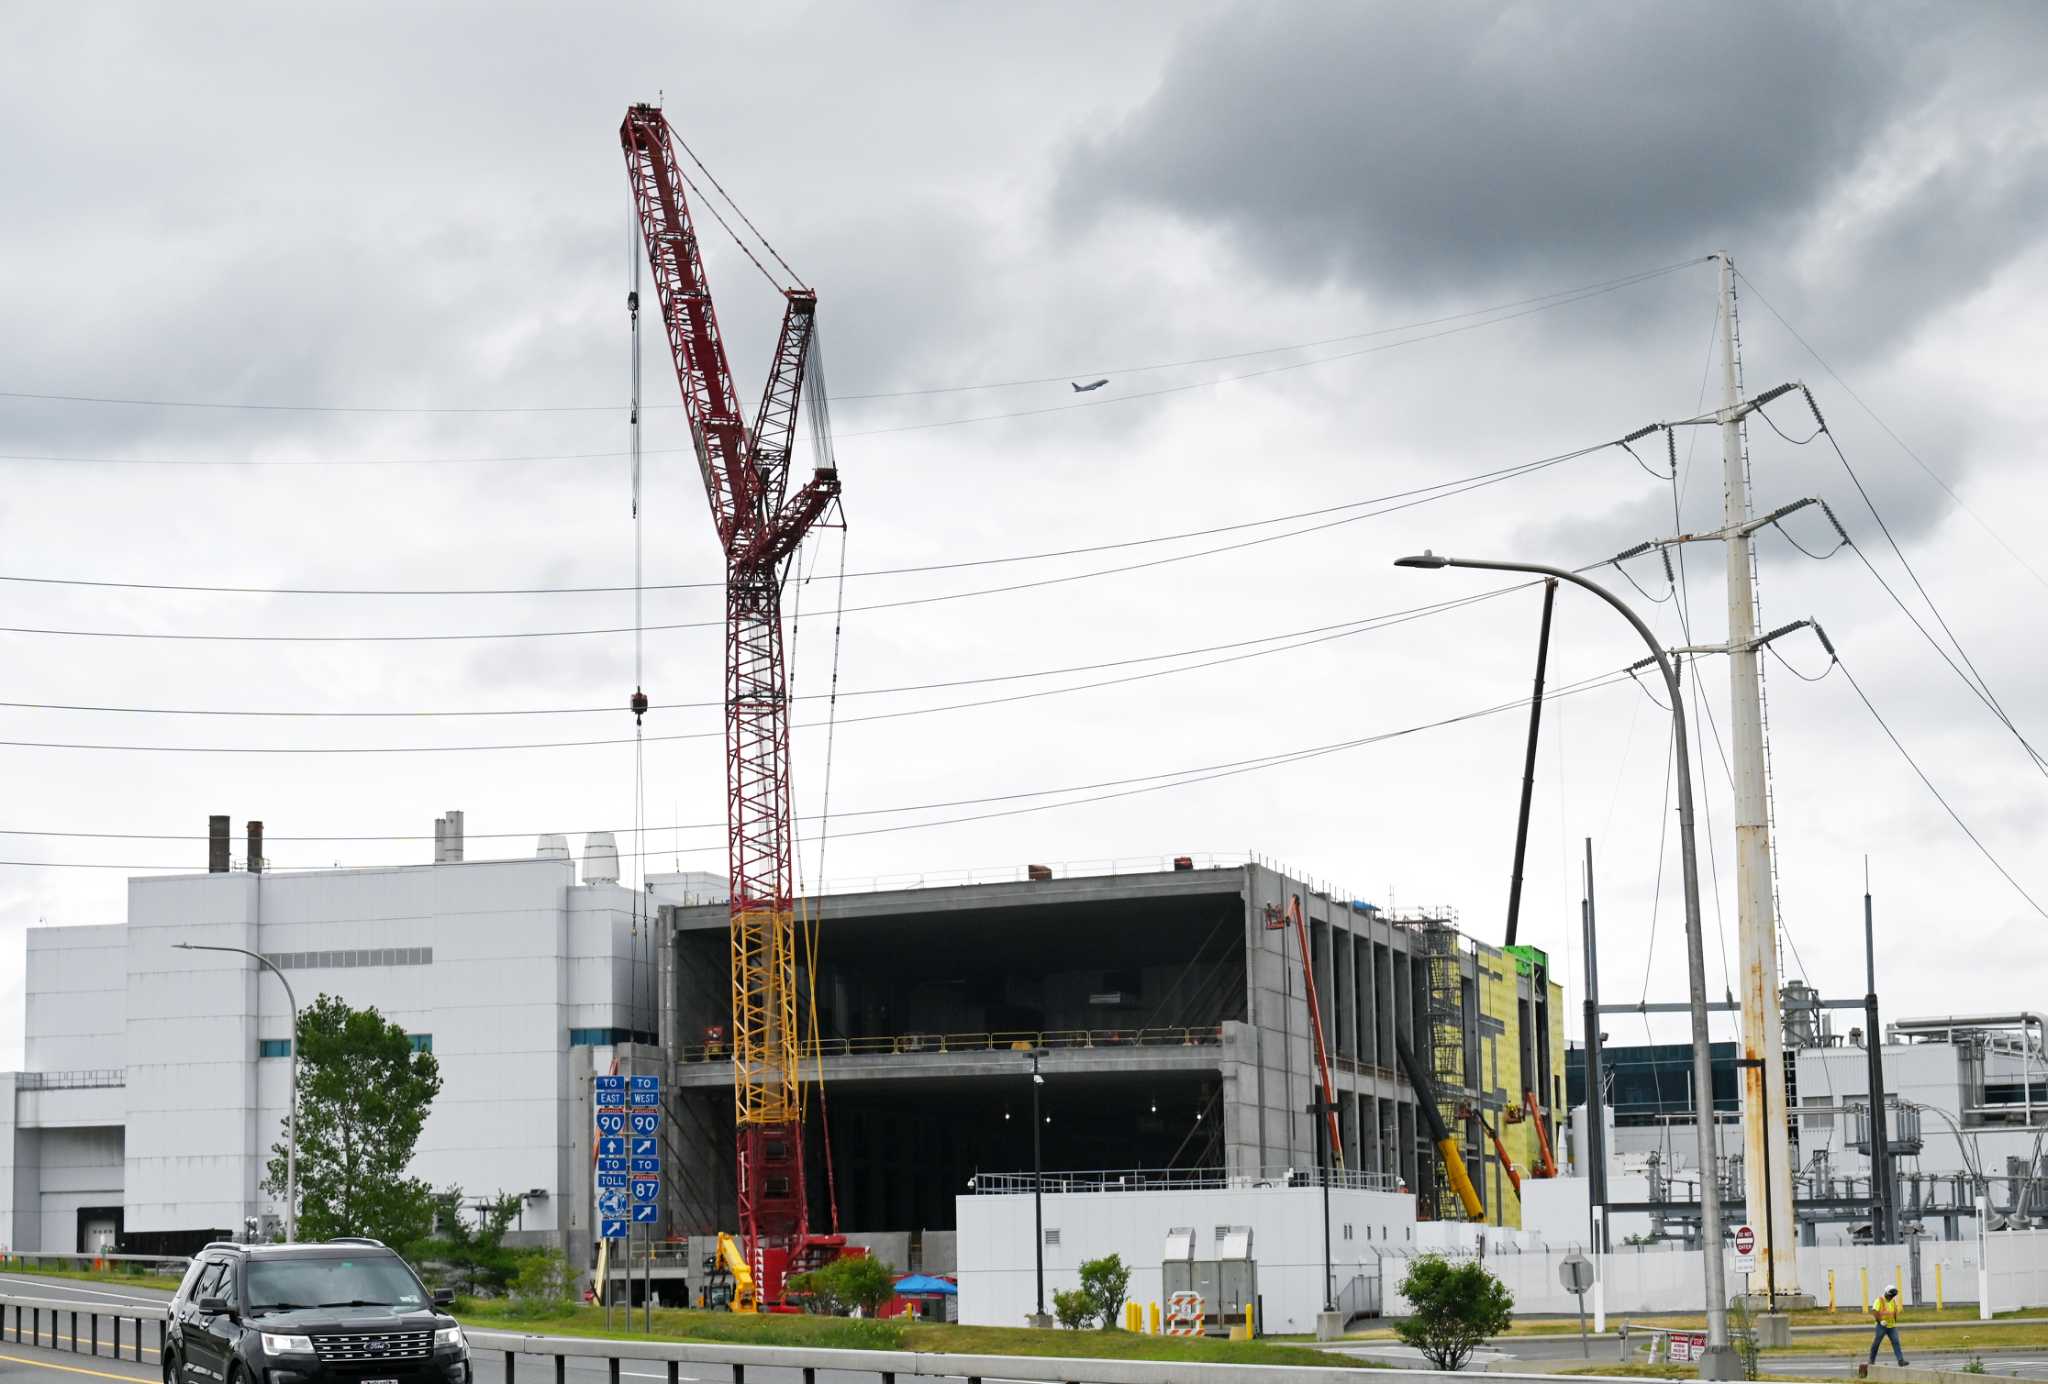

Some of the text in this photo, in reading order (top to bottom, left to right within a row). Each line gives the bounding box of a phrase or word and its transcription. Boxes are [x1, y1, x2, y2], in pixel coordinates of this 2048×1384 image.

[603, 1079, 617, 1088] TO
[637, 1079, 651, 1088] TO
[600, 1093, 621, 1103] EAST
[634, 1093, 655, 1103] WEST
[600, 1116, 621, 1130] 90
[634, 1116, 655, 1131] 90
[605, 1160, 619, 1169] TO
[638, 1160, 652, 1169] TO
[601, 1176, 625, 1185] TOLL
[635, 1183, 656, 1197] 87
